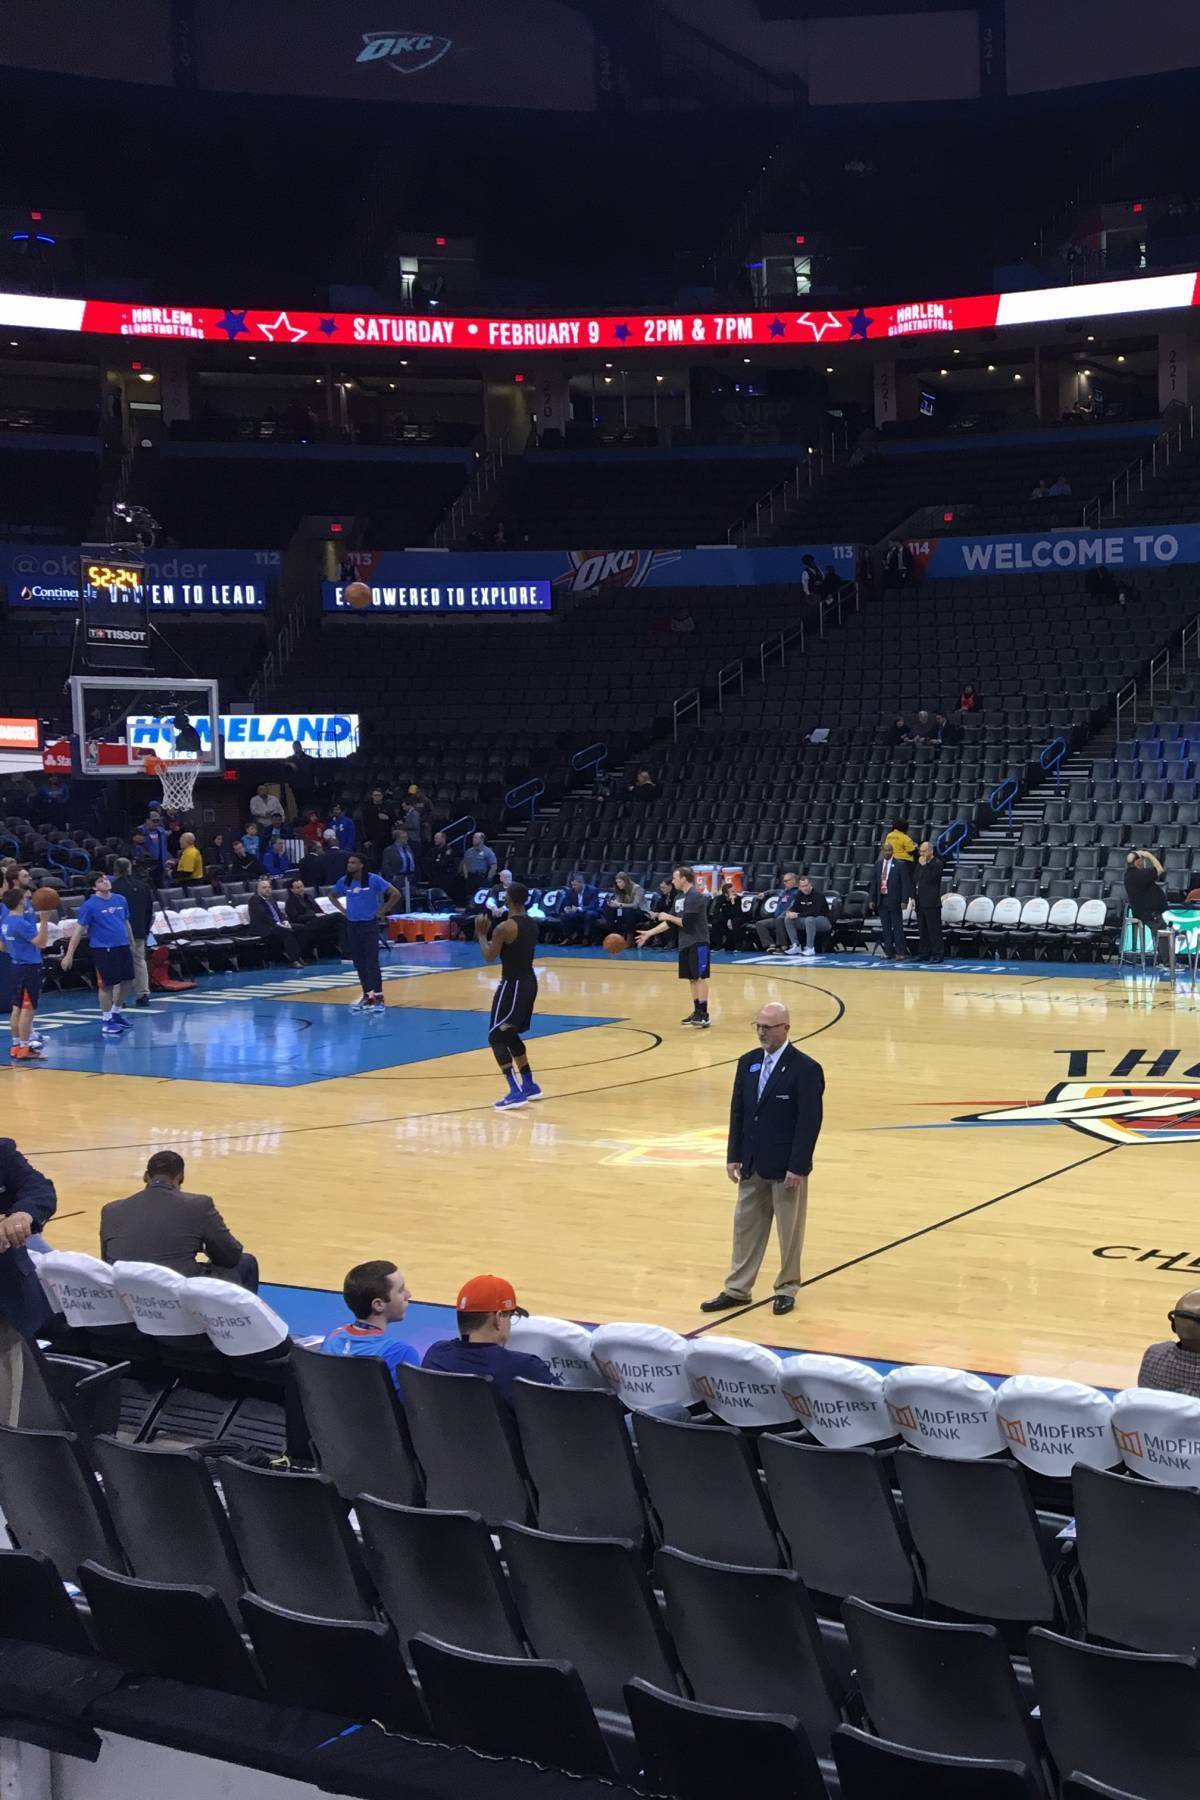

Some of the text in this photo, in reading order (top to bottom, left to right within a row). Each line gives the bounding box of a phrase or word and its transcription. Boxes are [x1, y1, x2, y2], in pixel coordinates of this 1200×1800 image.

[356, 35, 433, 63] OKC
[983, 28, 993, 75] 321
[132, 308, 193, 325] HARLEM
[896, 305, 944, 323] HARLEM
[121, 323, 205, 339] GLOBETROTTERS
[353, 317, 753, 345] SATURDAY FEBRUARY 9 2PM & 7PM
[887, 319, 954, 337] GLOBETROTTERS
[1168, 350, 1177, 391] 221
[832, 546, 853, 559] 113
[908, 542, 930, 555] 114
[962, 534, 1179, 571] WELCOME TO
[12, 553, 208, 579] @oknder
[253, 553, 281, 565] 112
[88, 566, 138, 588] 52:24
[572, 551, 635, 590] OKC
[183, 585, 203, 604] TO
[212, 585, 263, 604] LEAD.
[335, 586, 544, 607] EOWERED TO EXPLORE.
[106, 630, 146, 641] TISSOT
[716, 1391, 754, 1409] BANK
[920, 1424, 961, 1440] BANK
[1029, 1437, 1075, 1455] BANK
[1147, 1450, 1191, 1471] BANK
